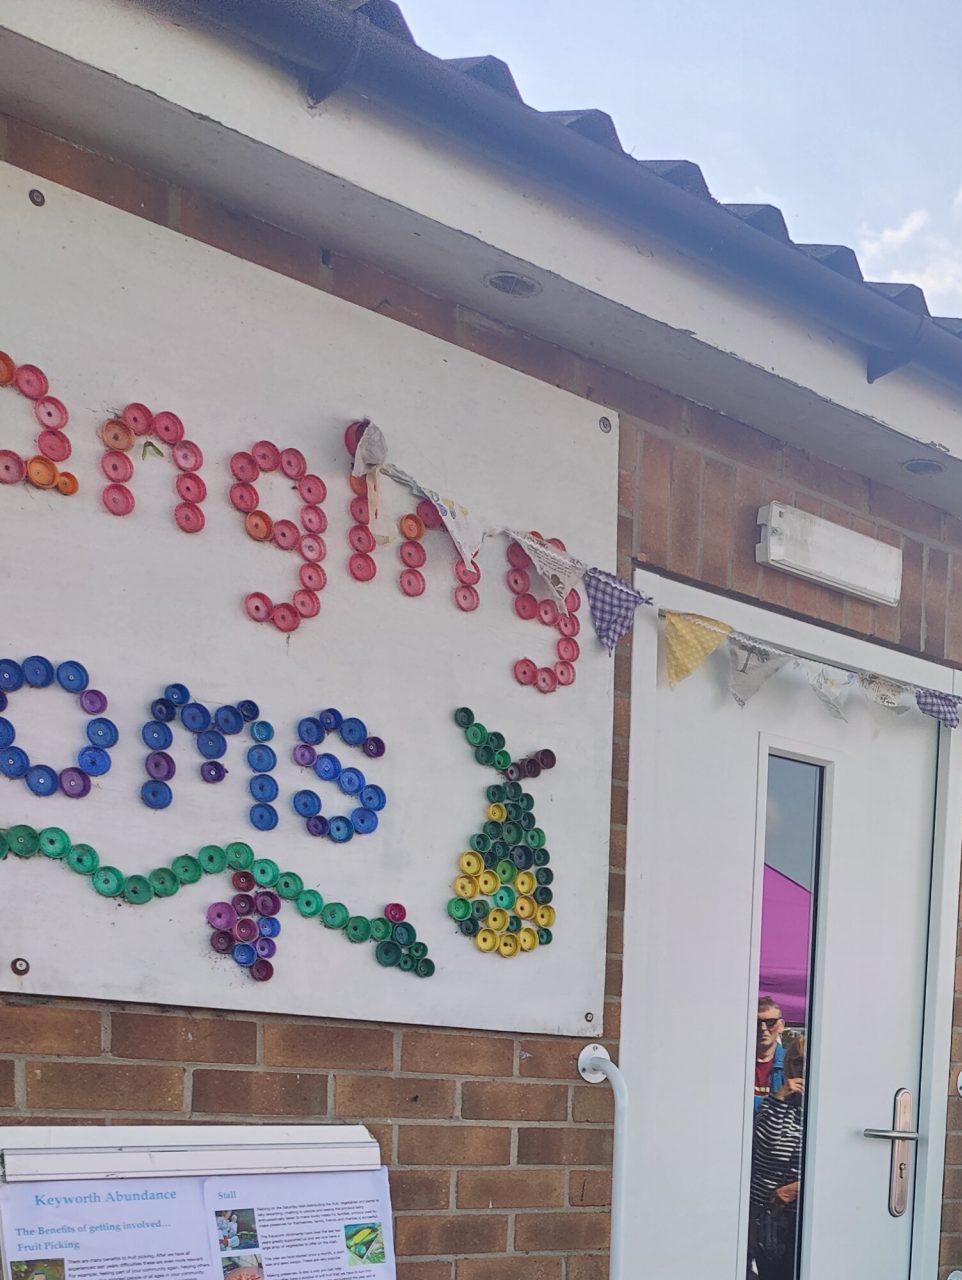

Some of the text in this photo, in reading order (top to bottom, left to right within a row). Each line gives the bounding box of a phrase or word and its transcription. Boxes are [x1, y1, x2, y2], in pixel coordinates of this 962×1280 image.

[34, 1190, 177, 1208] Keyworth Abundance
[218, 1191, 237, 1200] Stall
[16, 1227, 36, 1237] The
[37, 1225, 76, 1236] Benefits
[77, 1223, 88, 1233] of
[89, 1223, 122, 1235] getting
[17, 1240, 80, 1252] Fruit Picking
